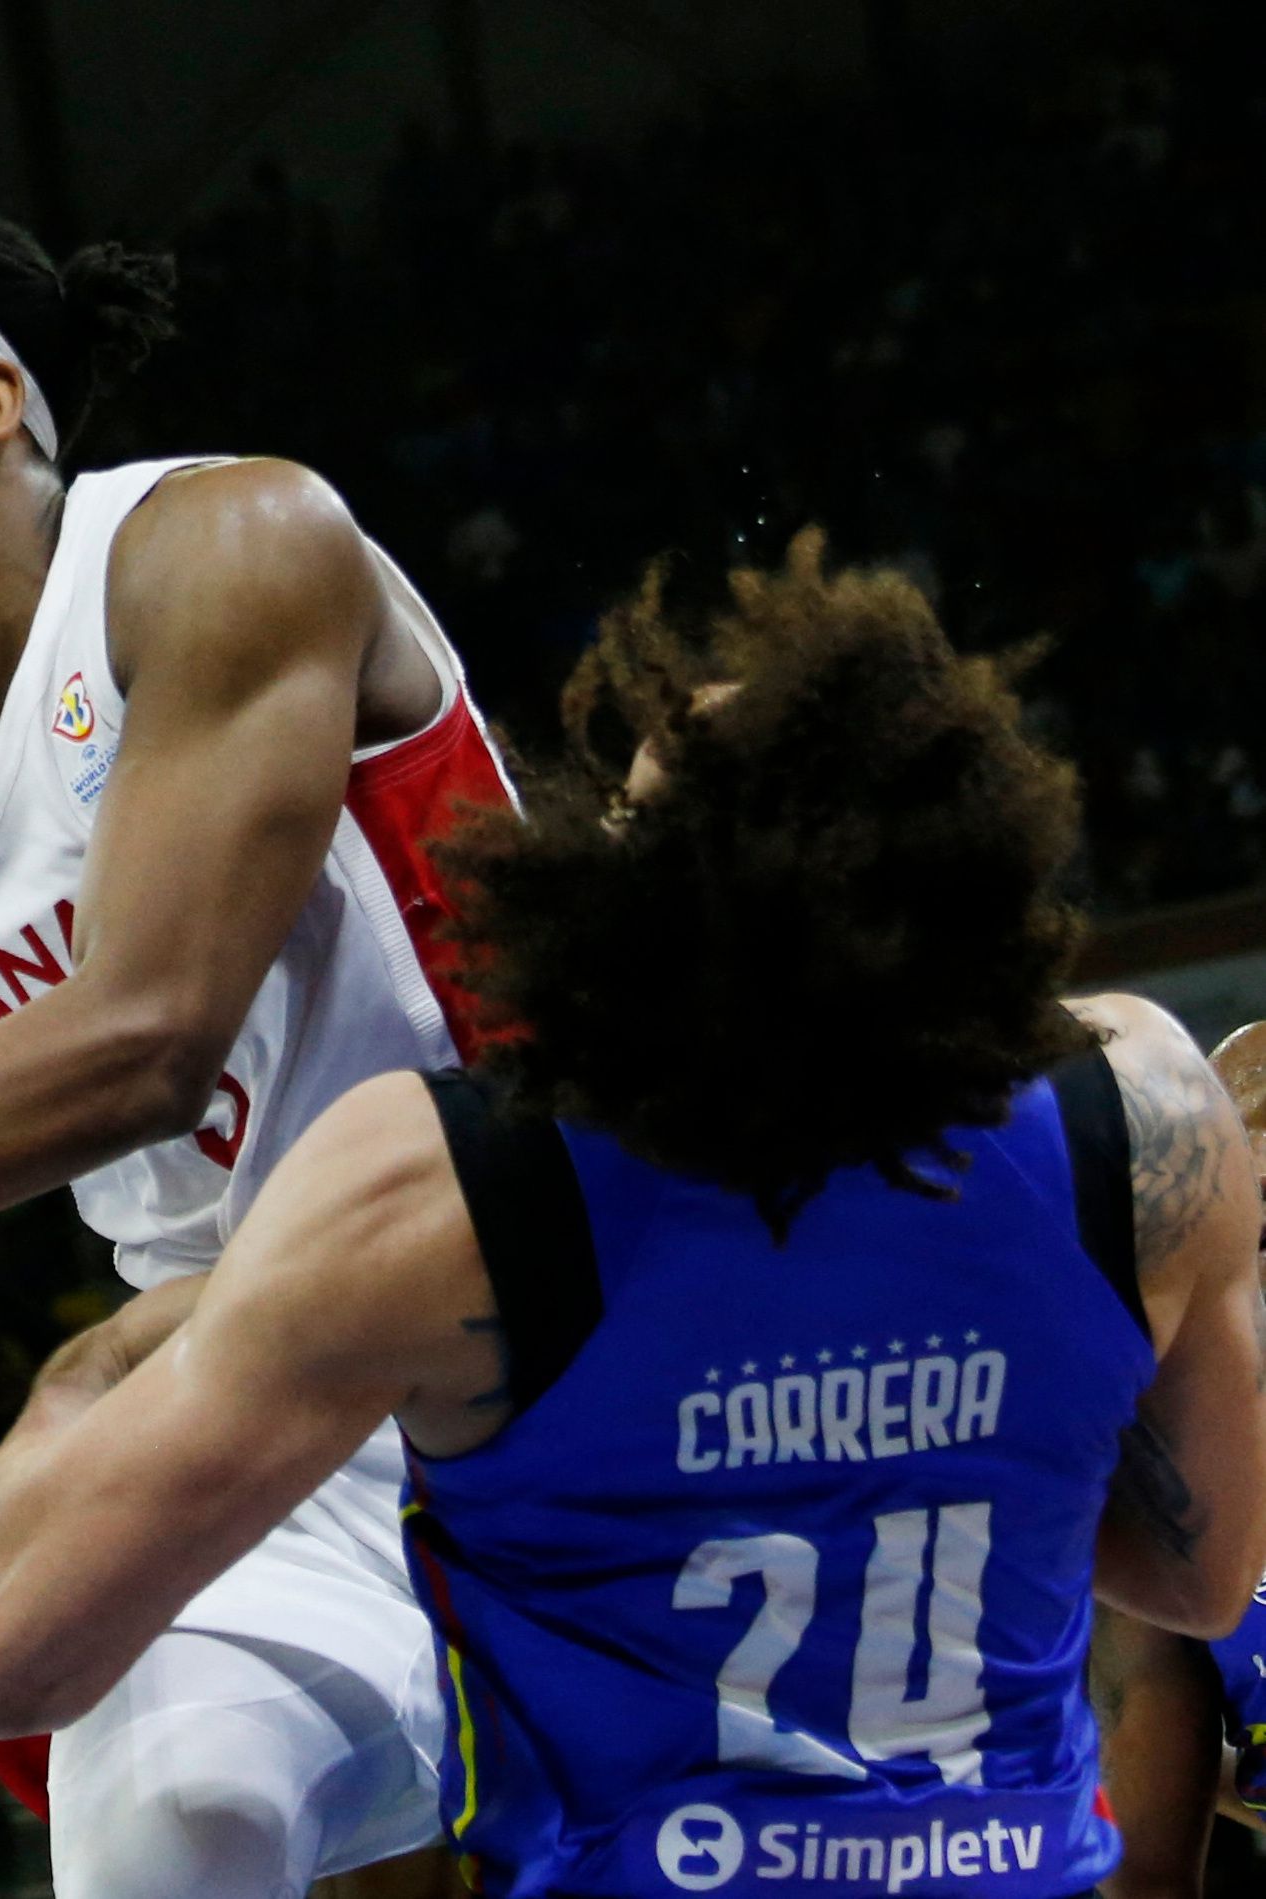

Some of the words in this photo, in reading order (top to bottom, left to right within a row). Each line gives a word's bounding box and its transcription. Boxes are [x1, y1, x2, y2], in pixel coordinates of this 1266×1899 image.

[74, 762, 107, 794] WORLD
[676, 1350, 1006, 1474] CARRERA
[672, 1502, 992, 1788] 24
[756, 1818, 1043, 1893] Simpletv
